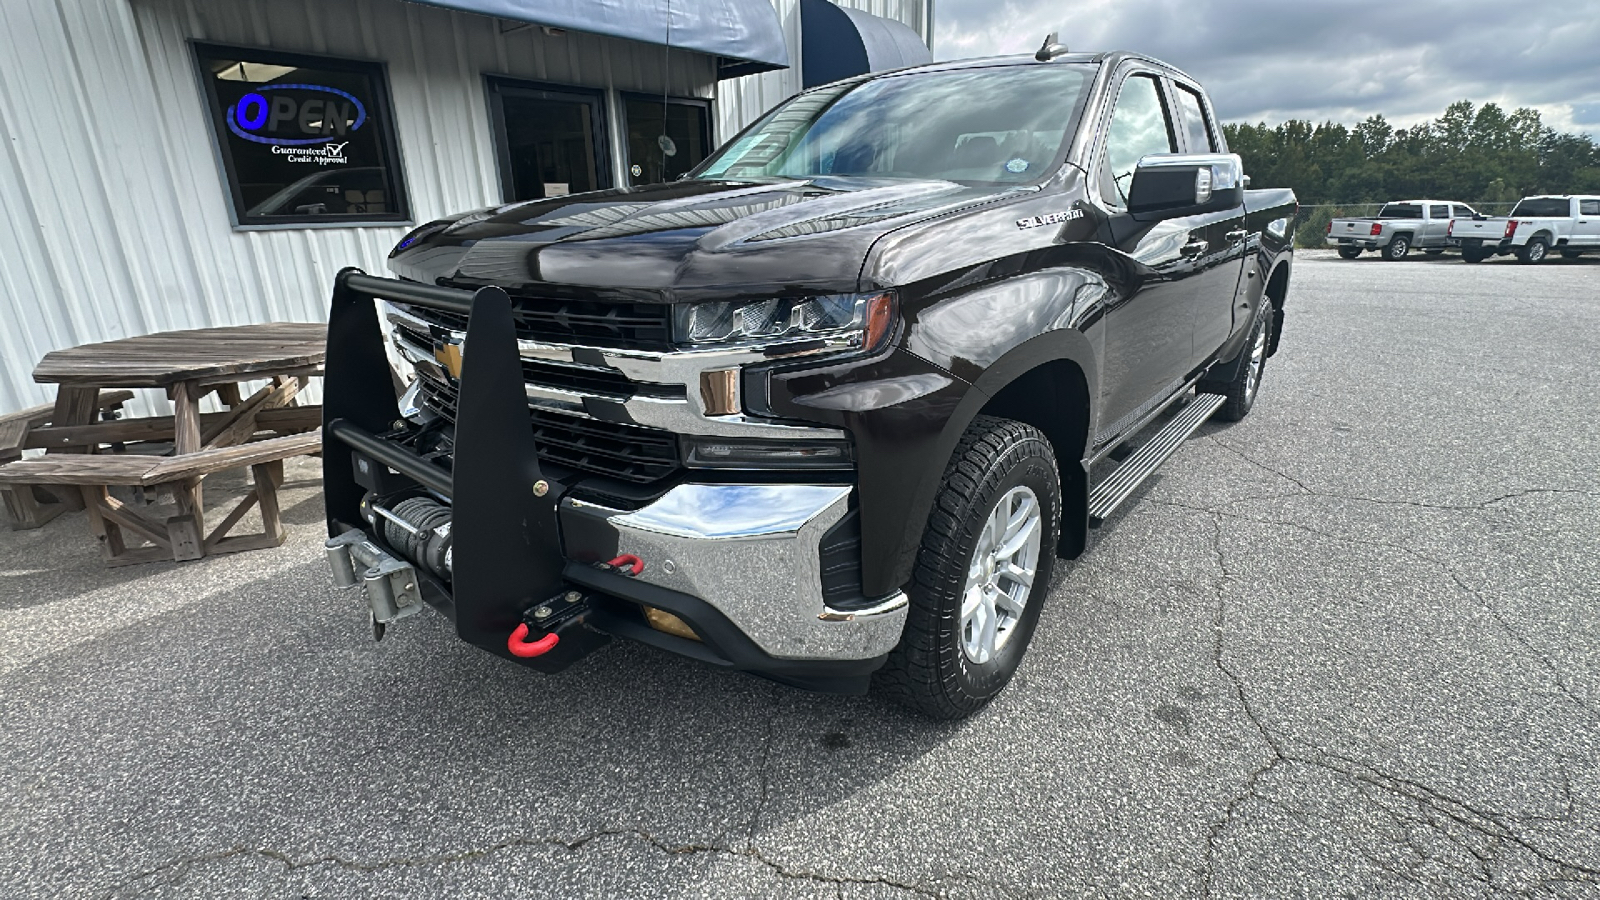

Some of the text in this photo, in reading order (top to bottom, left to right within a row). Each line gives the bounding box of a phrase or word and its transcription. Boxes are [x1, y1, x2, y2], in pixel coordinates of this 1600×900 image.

[236, 92, 349, 136] OPEN
[271, 145, 327, 156] Guaranteed
[288, 155, 348, 166] Credit Approval
